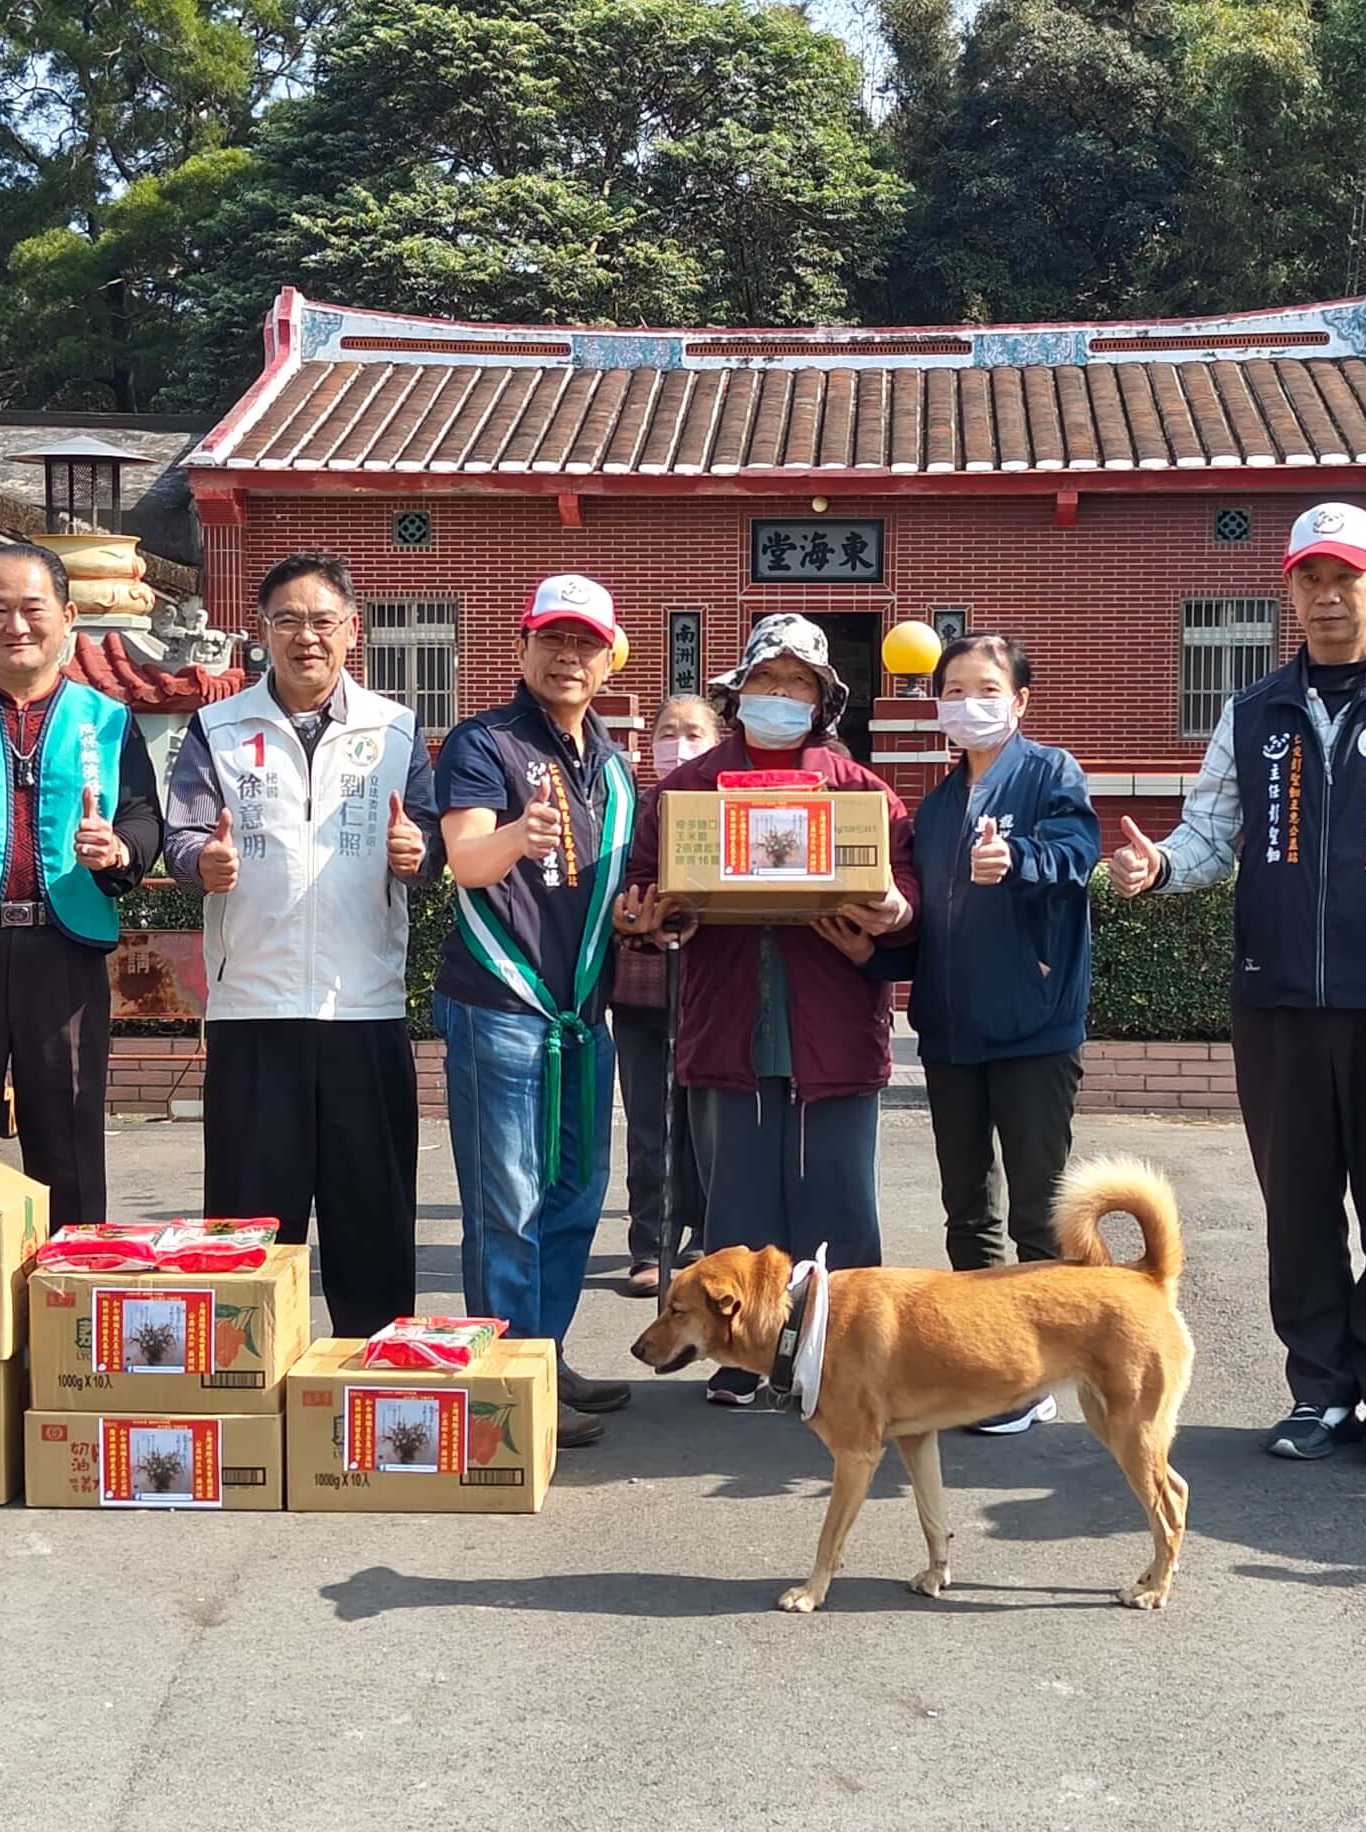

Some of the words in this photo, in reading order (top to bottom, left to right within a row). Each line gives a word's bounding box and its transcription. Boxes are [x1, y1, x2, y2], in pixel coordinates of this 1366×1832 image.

[675, 624, 695, 694] 南洲世
[242, 732, 265, 768] 1
[236, 773, 266, 860] 徐意明
[339, 774, 365, 857] 劉仁照
